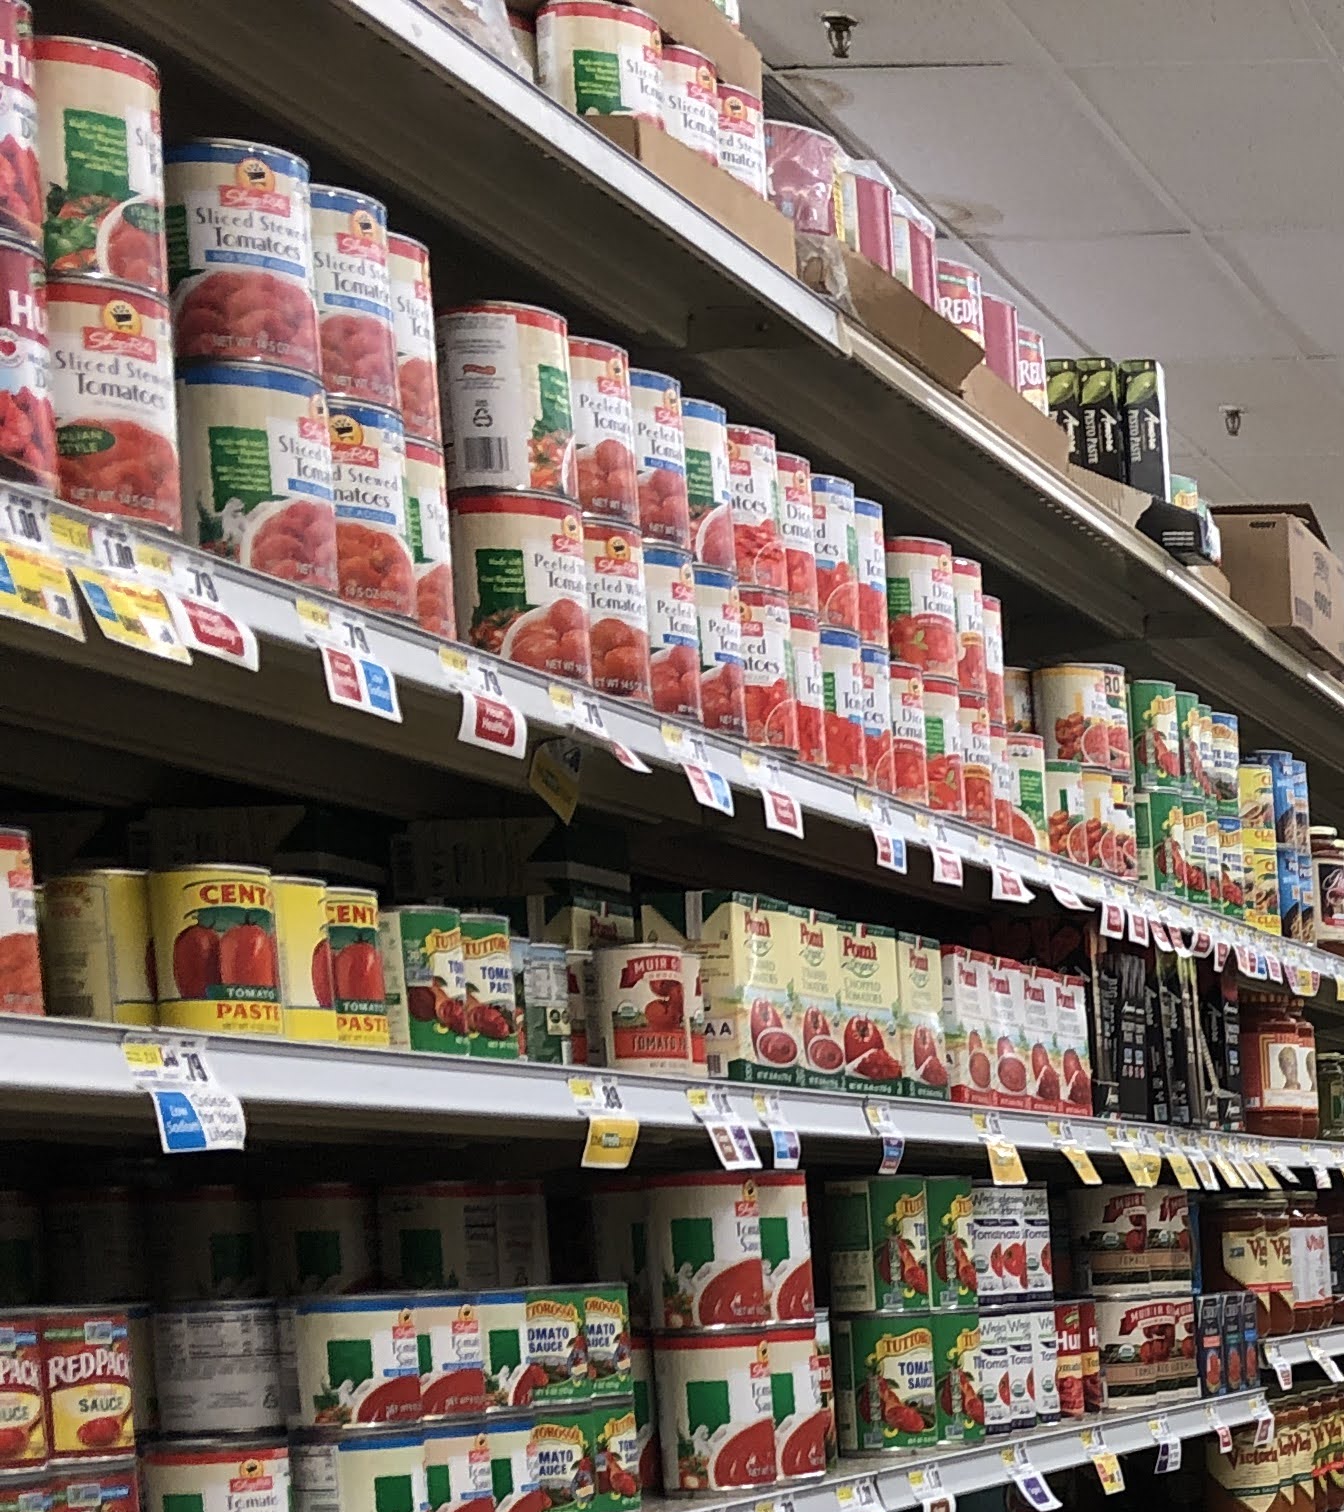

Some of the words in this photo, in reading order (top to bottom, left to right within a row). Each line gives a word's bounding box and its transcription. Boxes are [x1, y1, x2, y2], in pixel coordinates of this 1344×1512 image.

[196, 208, 254, 230] Sliced
[213, 228, 301, 259] Tomatoes
[313, 251, 365, 275] Sliced
[939, 297, 981, 325] REDP
[54, 350, 120, 377] Sliced
[588, 591, 645, 611] Tomatoe
[480, 965, 511, 981] TOMA
[633, 959, 665, 974] MUIR
[489, 982, 512, 993] PAST
[217, 1004, 280, 1020] PASTE
[528, 1327, 569, 1342] OMATO
[587, 1323, 615, 1337] MATO
[529, 1340, 563, 1354] SAUCE
[0, 1354, 40, 1387] PACK
[899, 1362, 935, 1377] TOMAT
[78, 1396, 124, 1413] SAUCE
[0, 1405, 30, 1424] UCE
[539, 1450, 574, 1465] MATO
[539, 1464, 567, 1476] AUCE
[225, 1493, 280, 1511] Tomato
